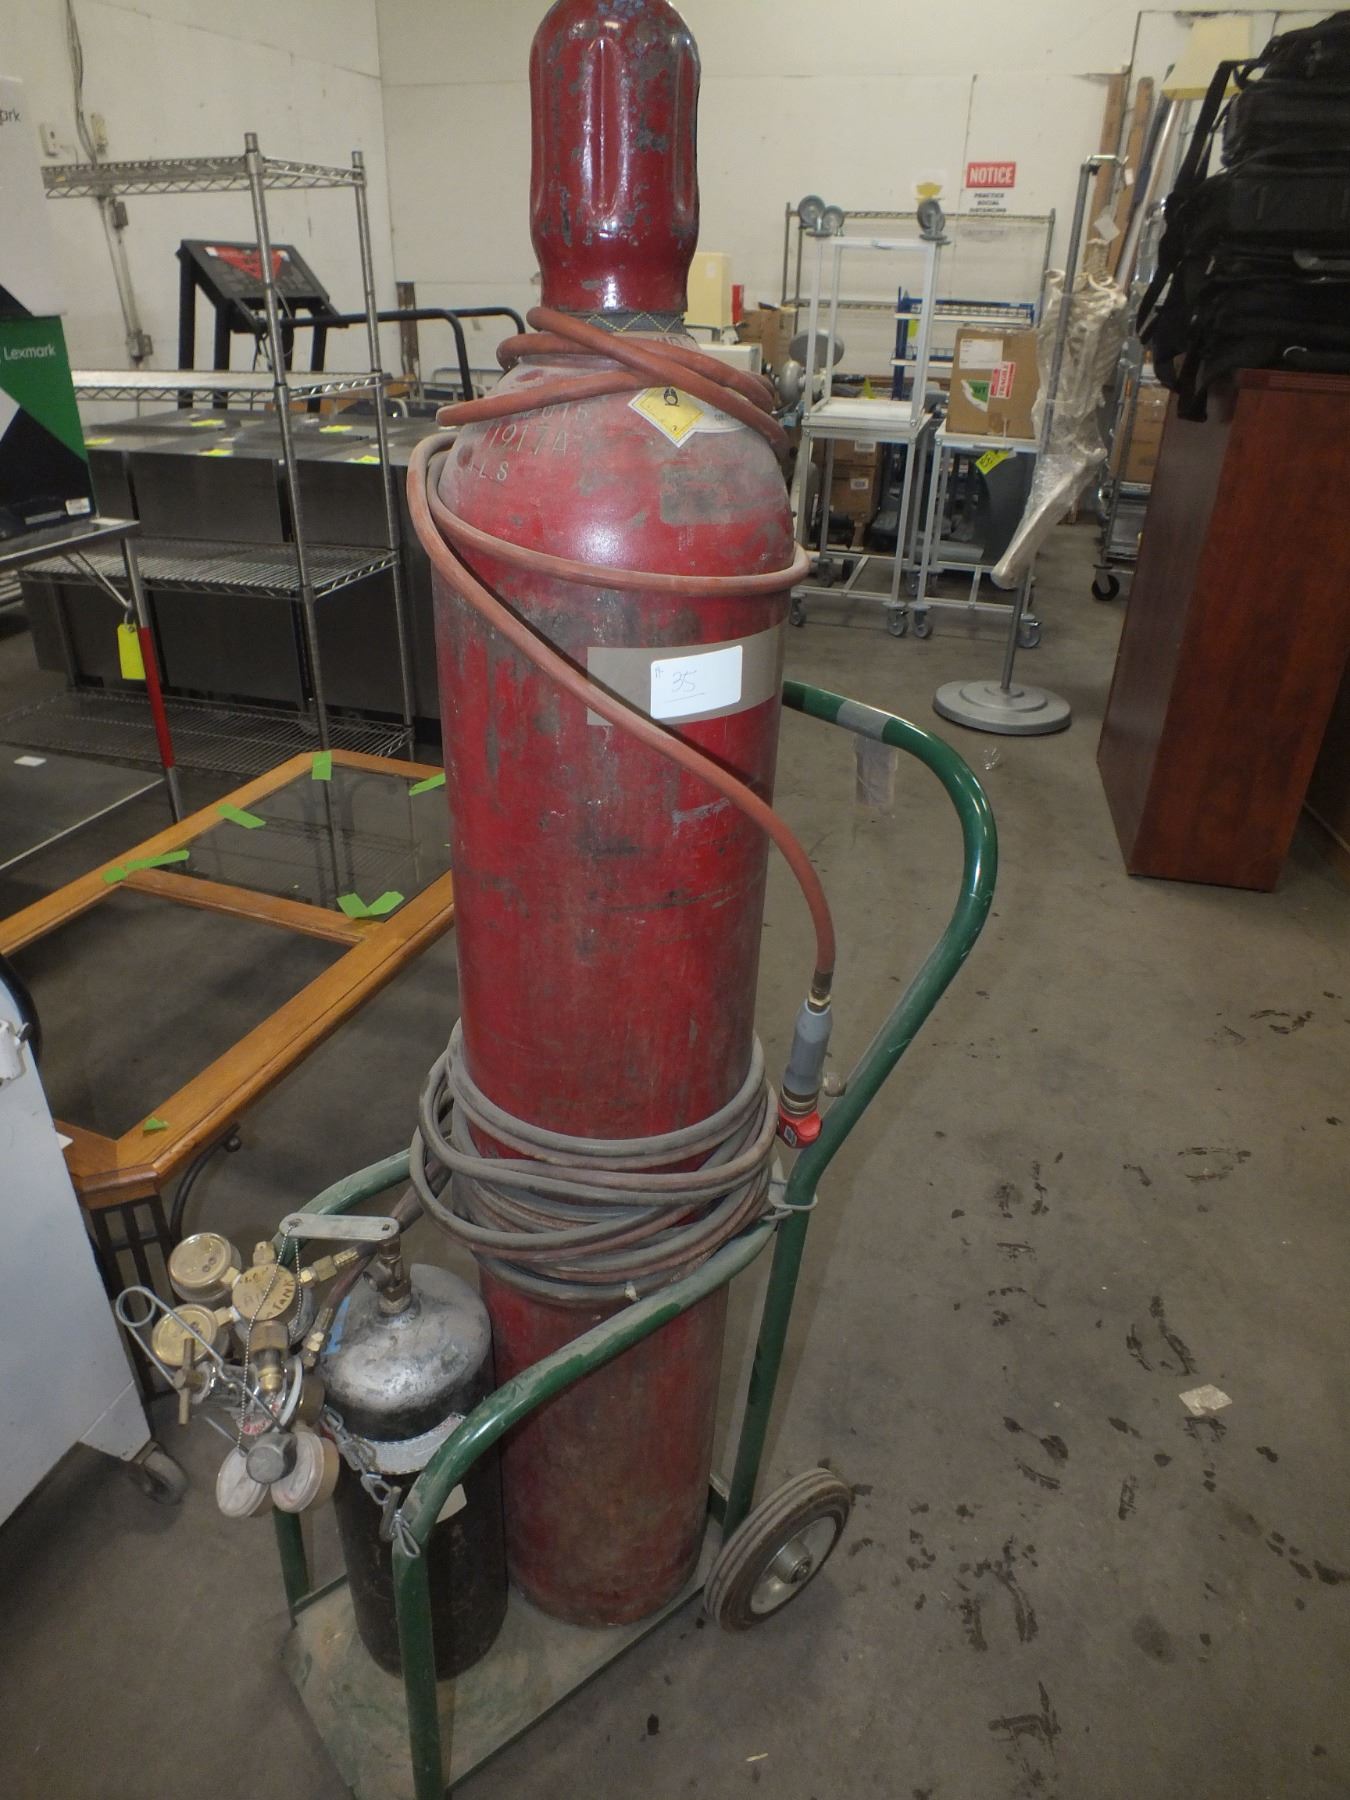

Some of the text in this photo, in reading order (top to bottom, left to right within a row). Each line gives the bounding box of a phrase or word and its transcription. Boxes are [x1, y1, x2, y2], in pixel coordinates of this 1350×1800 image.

[968, 166, 1014, 185] NOTICE
[3, 344, 56, 361] Lexmark
[671, 669, 698, 693] 35
